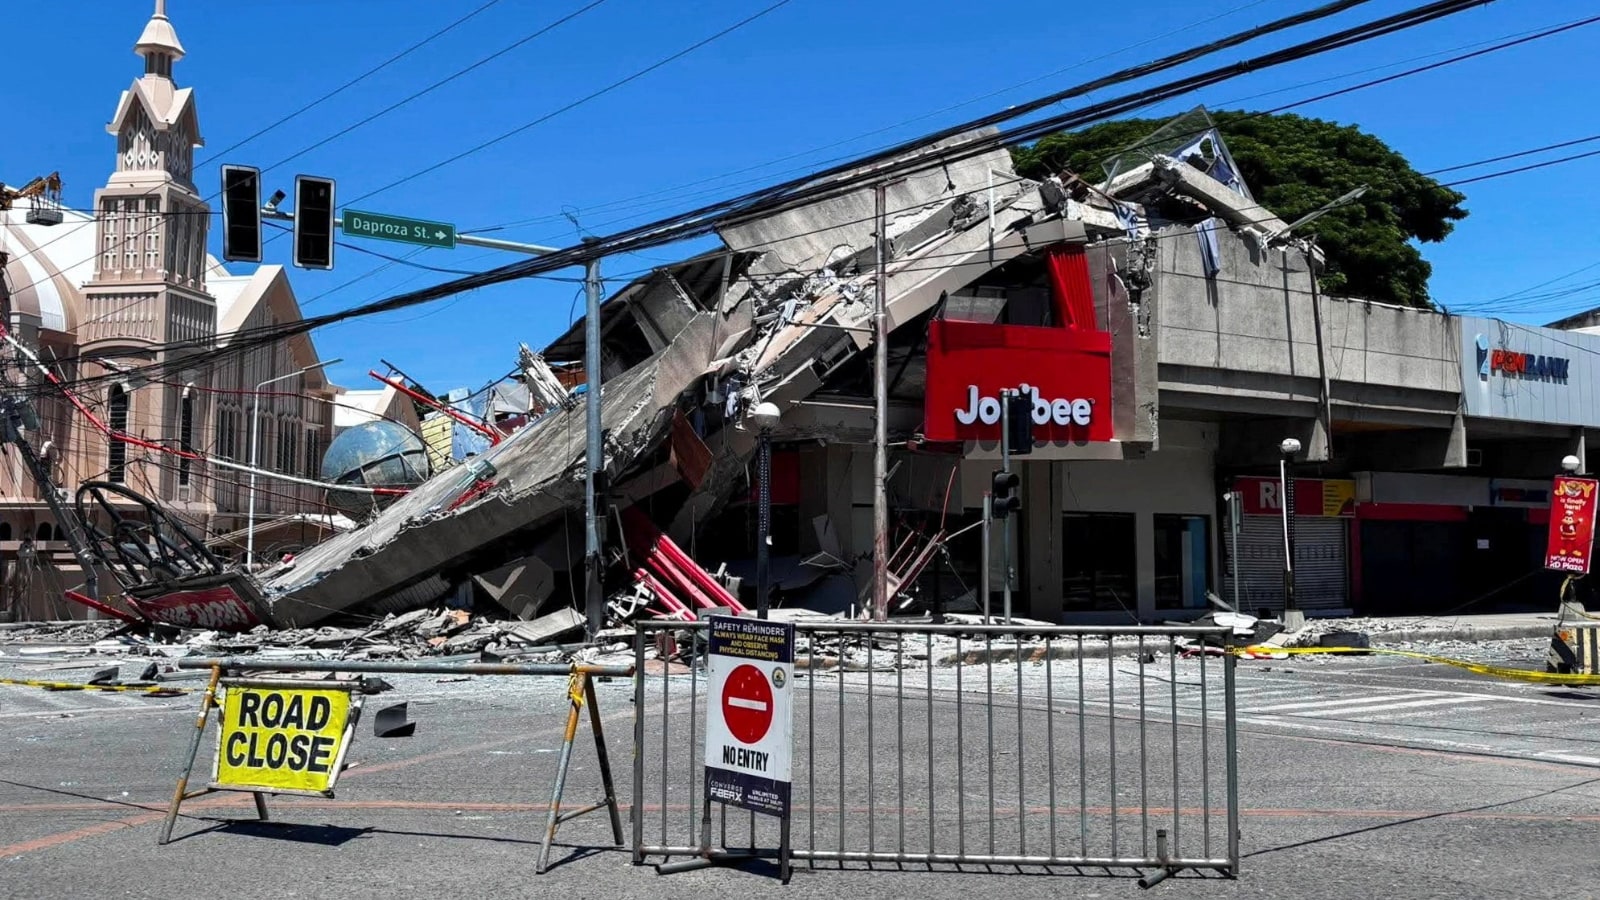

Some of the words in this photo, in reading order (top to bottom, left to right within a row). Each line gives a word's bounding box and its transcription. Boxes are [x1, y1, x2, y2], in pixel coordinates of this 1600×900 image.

[353, 217, 408, 236] Daproza
[414, 226, 430, 239] St.
[954, 383, 1091, 426] Jobee
[1260, 481, 1284, 509] R
[1566, 497, 1587, 507] finally
[1550, 554, 1567, 562] NOW
[1562, 562, 1584, 571] Plaza
[714, 621, 741, 632] SAFETY
[743, 624, 785, 636] REMINDERS
[713, 631, 737, 640] ALWAYS
[737, 632, 754, 641] WEAR
[754, 634, 768, 643] FACE
[769, 636, 785, 644] MASK
[719, 645, 745, 655] PHYSICAL
[746, 648, 779, 659] DISTANCING
[743, 641, 768, 650] OBSERVE
[238, 692, 331, 731] ROAD
[226, 731, 335, 773] CLOSE
[722, 744, 736, 765] NO
[737, 747, 769, 772] ENTRY
[710, 780, 743, 793] CONVERGE
